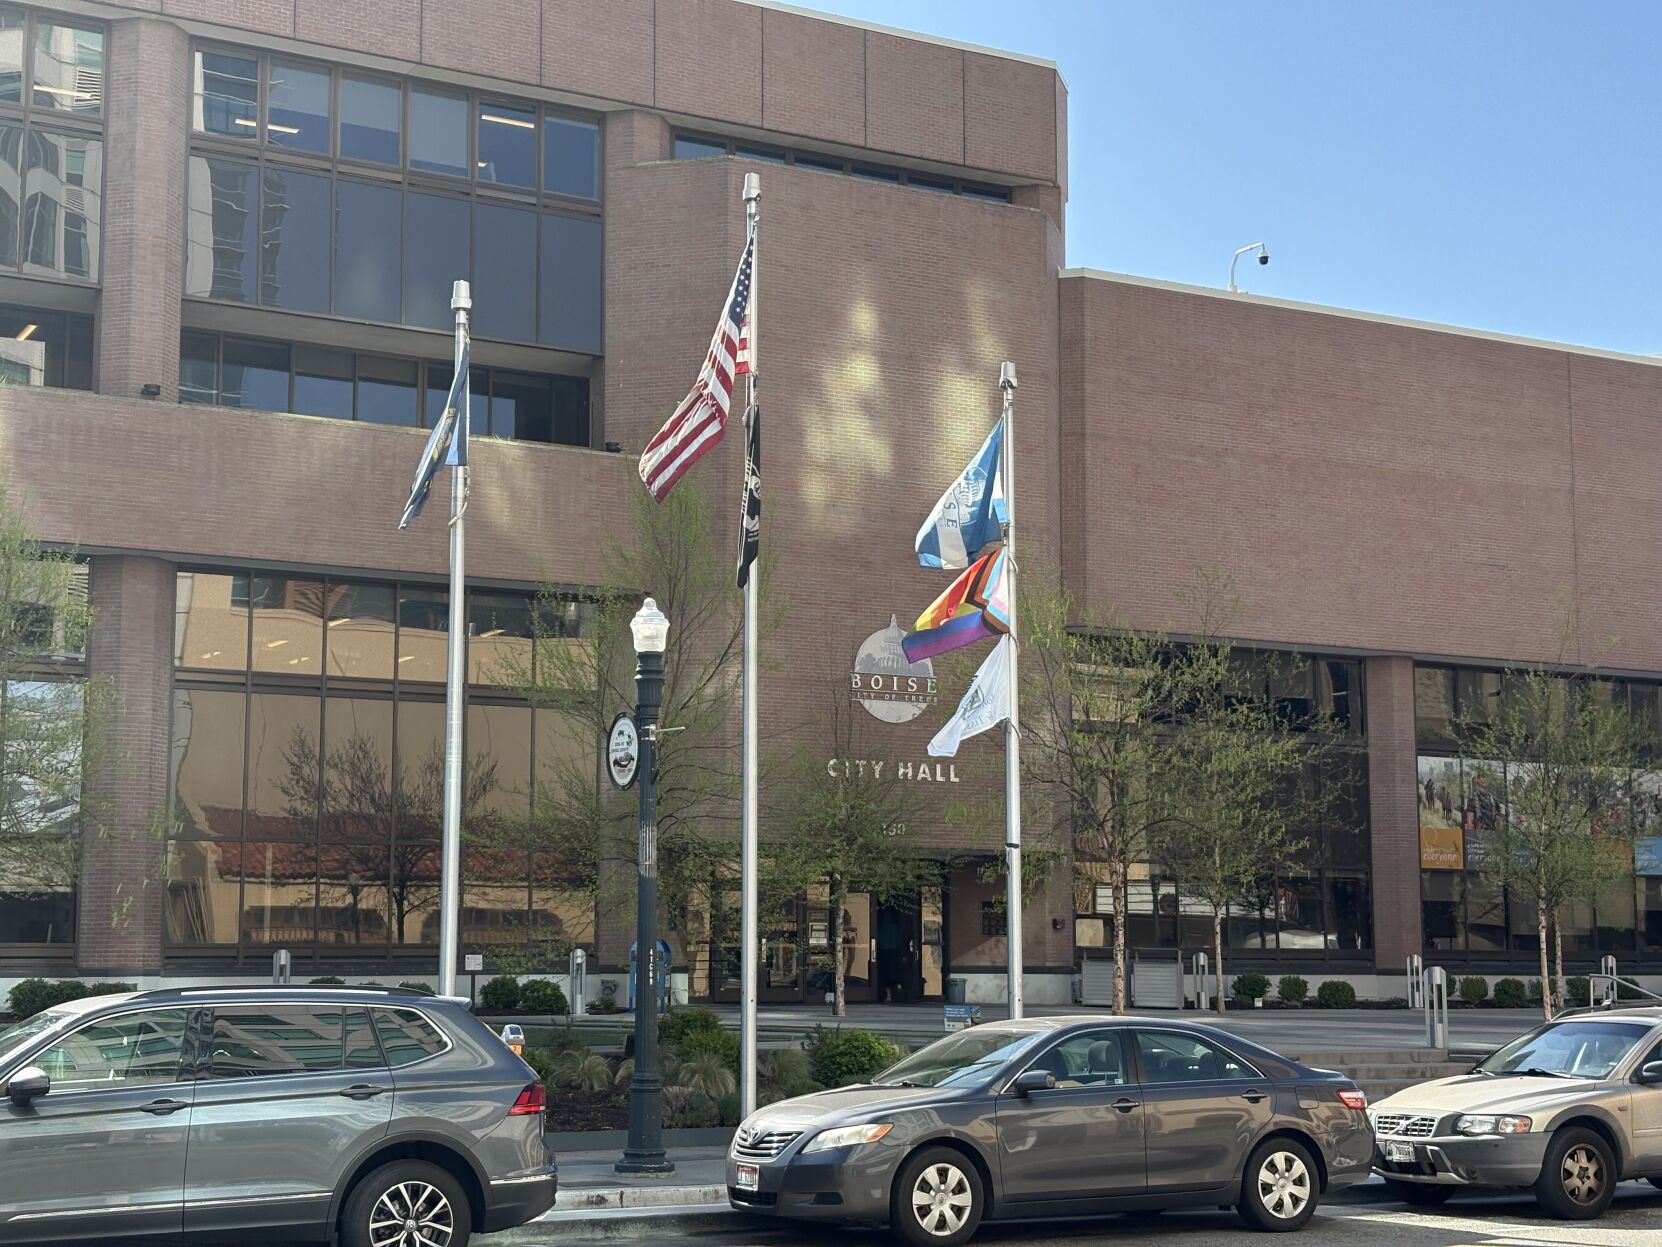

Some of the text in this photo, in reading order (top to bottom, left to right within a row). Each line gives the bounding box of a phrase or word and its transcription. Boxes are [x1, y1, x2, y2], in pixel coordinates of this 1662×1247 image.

[851, 673, 937, 693] BOISE
[850, 691, 876, 699] ITY
[884, 693, 896, 701] OF
[827, 758, 960, 783] CITY HALL
